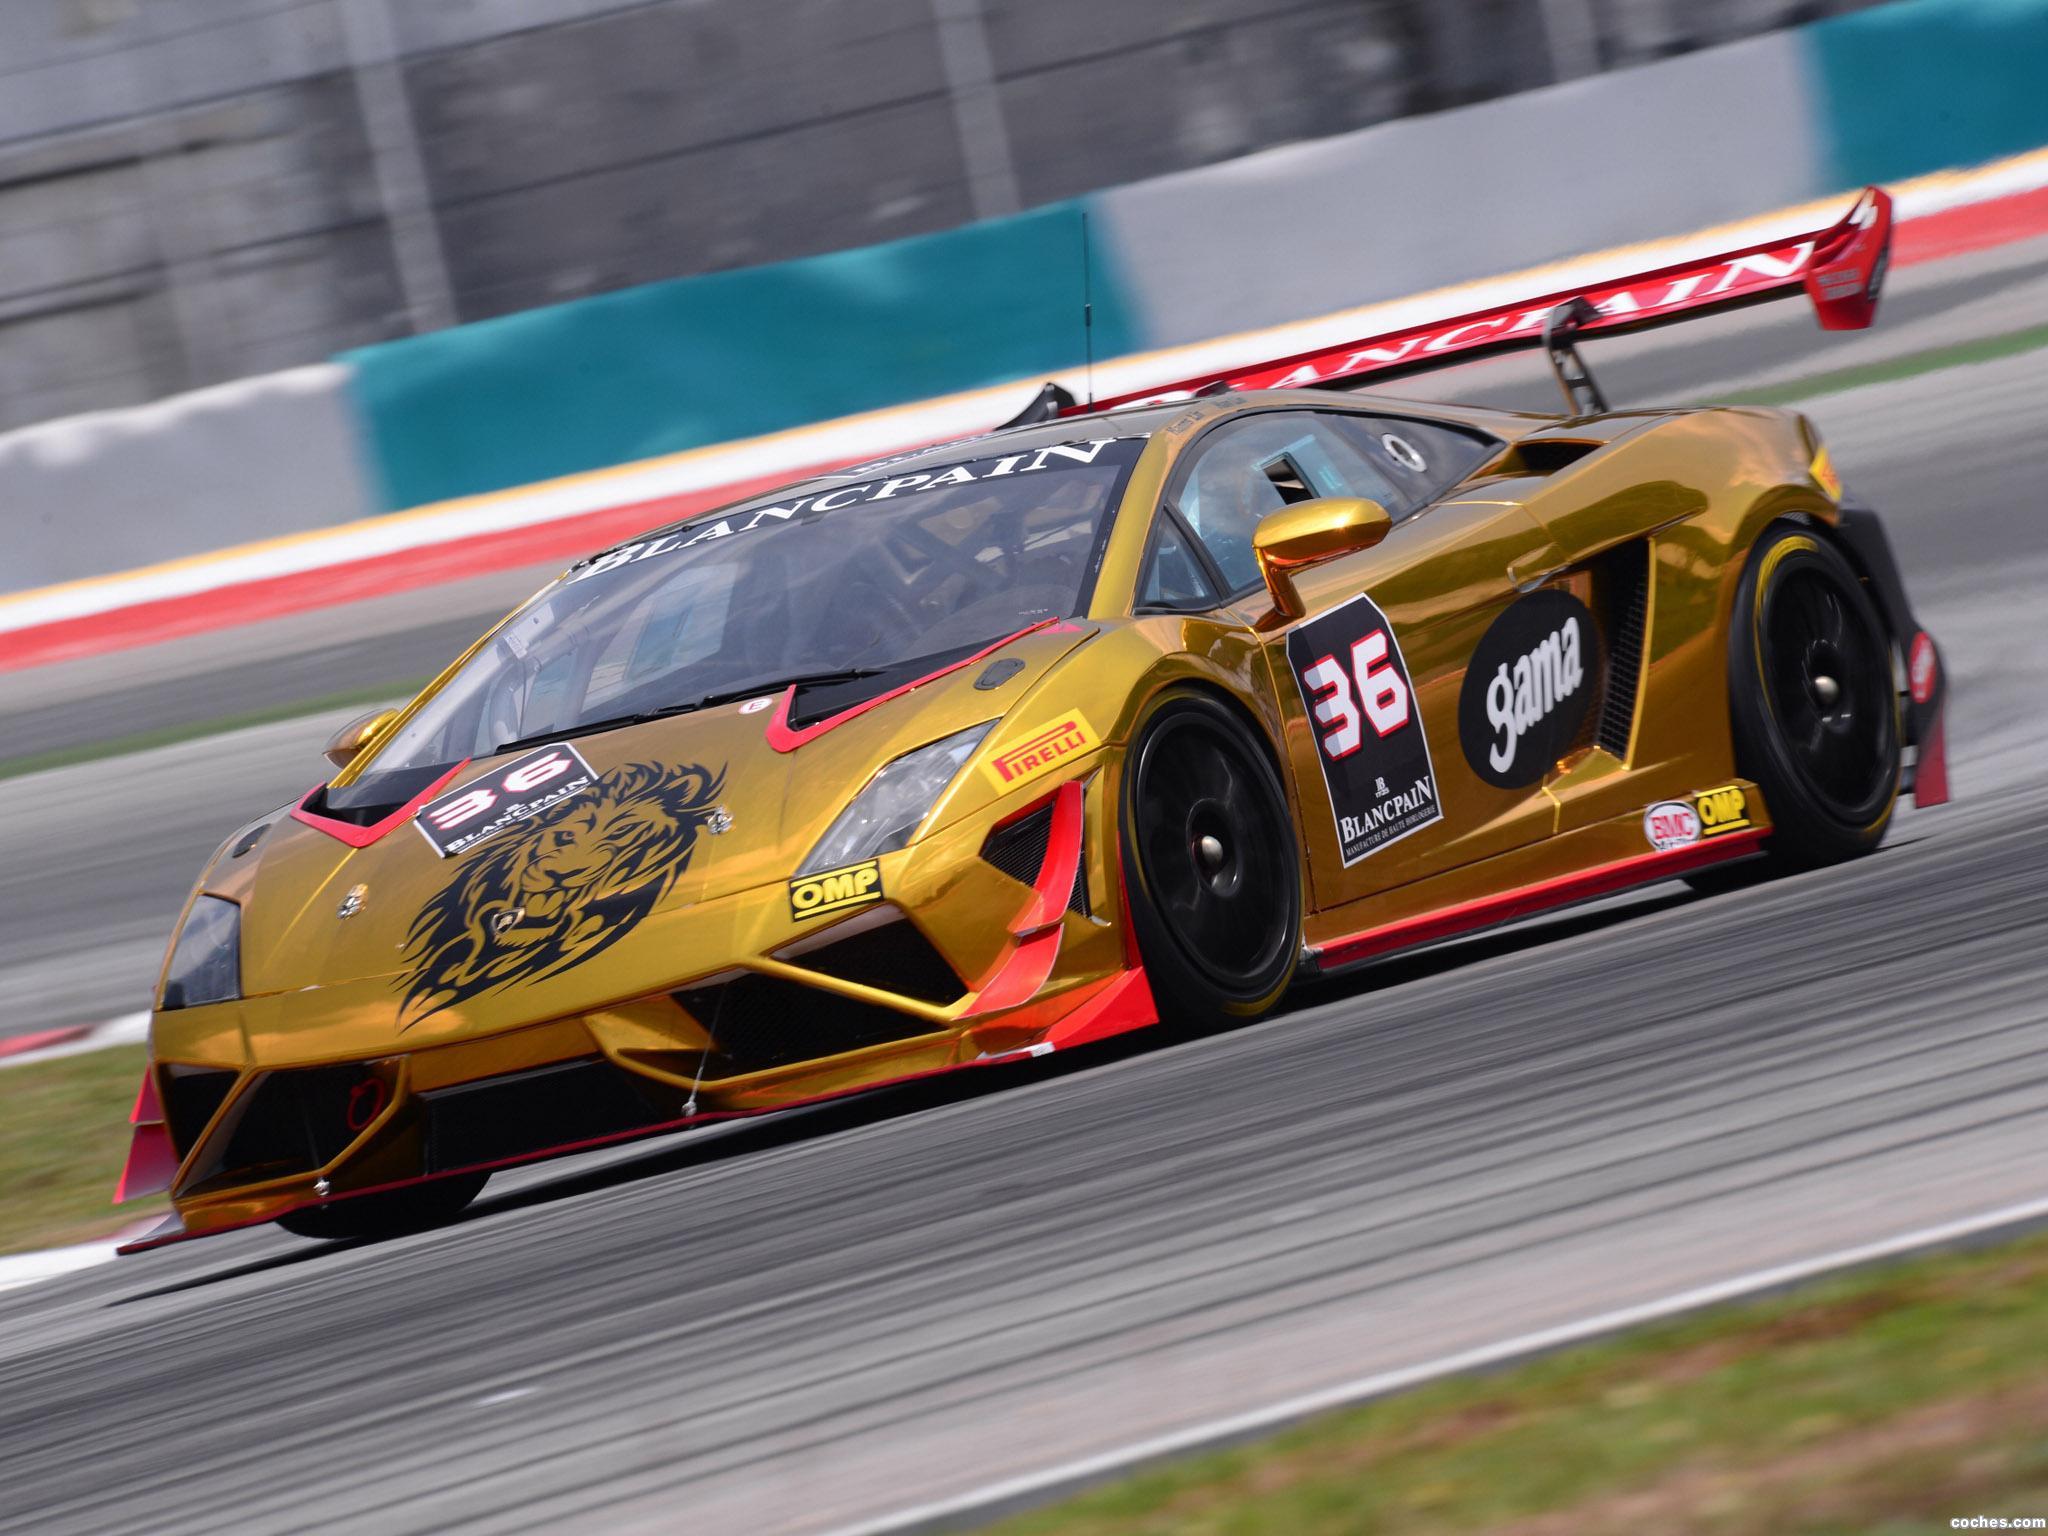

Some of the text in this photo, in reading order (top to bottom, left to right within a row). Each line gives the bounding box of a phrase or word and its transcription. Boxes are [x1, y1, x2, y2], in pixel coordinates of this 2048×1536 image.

[566, 440, 1117, 586] BLANCPAIN
[1303, 628, 1409, 761] 36
[1486, 617, 1584, 774] gama
[991, 720, 1087, 783] PIRELLI
[428, 751, 574, 831] 36
[445, 776, 590, 853] BLANCPAIN
[1340, 776, 1432, 844] BLANCPAIN
[1698, 789, 1745, 826] OMP
[1345, 832, 1381, 857] MANUFACTURE
[1381, 828, 1389, 839] DE
[1389, 820, 1406, 835] HAUTE
[1651, 812, 1694, 840] BMC
[792, 867, 880, 909] OMP
